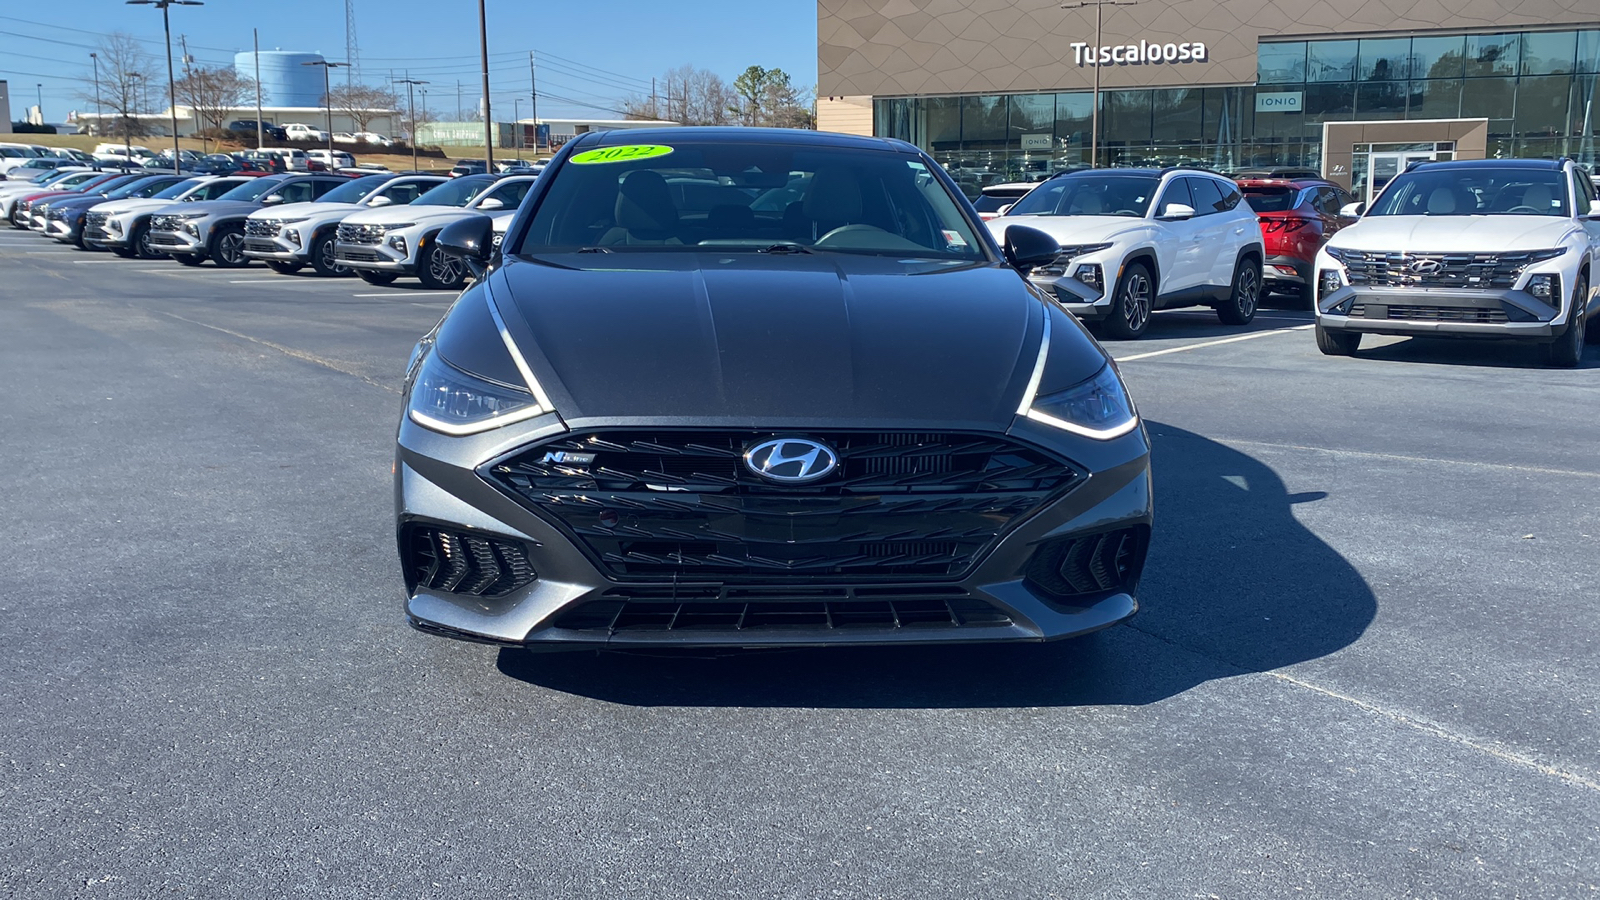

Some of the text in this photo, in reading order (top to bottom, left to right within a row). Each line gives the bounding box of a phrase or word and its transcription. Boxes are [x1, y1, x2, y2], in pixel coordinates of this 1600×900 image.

[1069, 39, 1207, 65] Tuscaloosa
[433, 129, 450, 139] CHINA
[452, 129, 480, 140] SHIPPING
[587, 146, 656, 162] 2022
[542, 451, 567, 463] N
